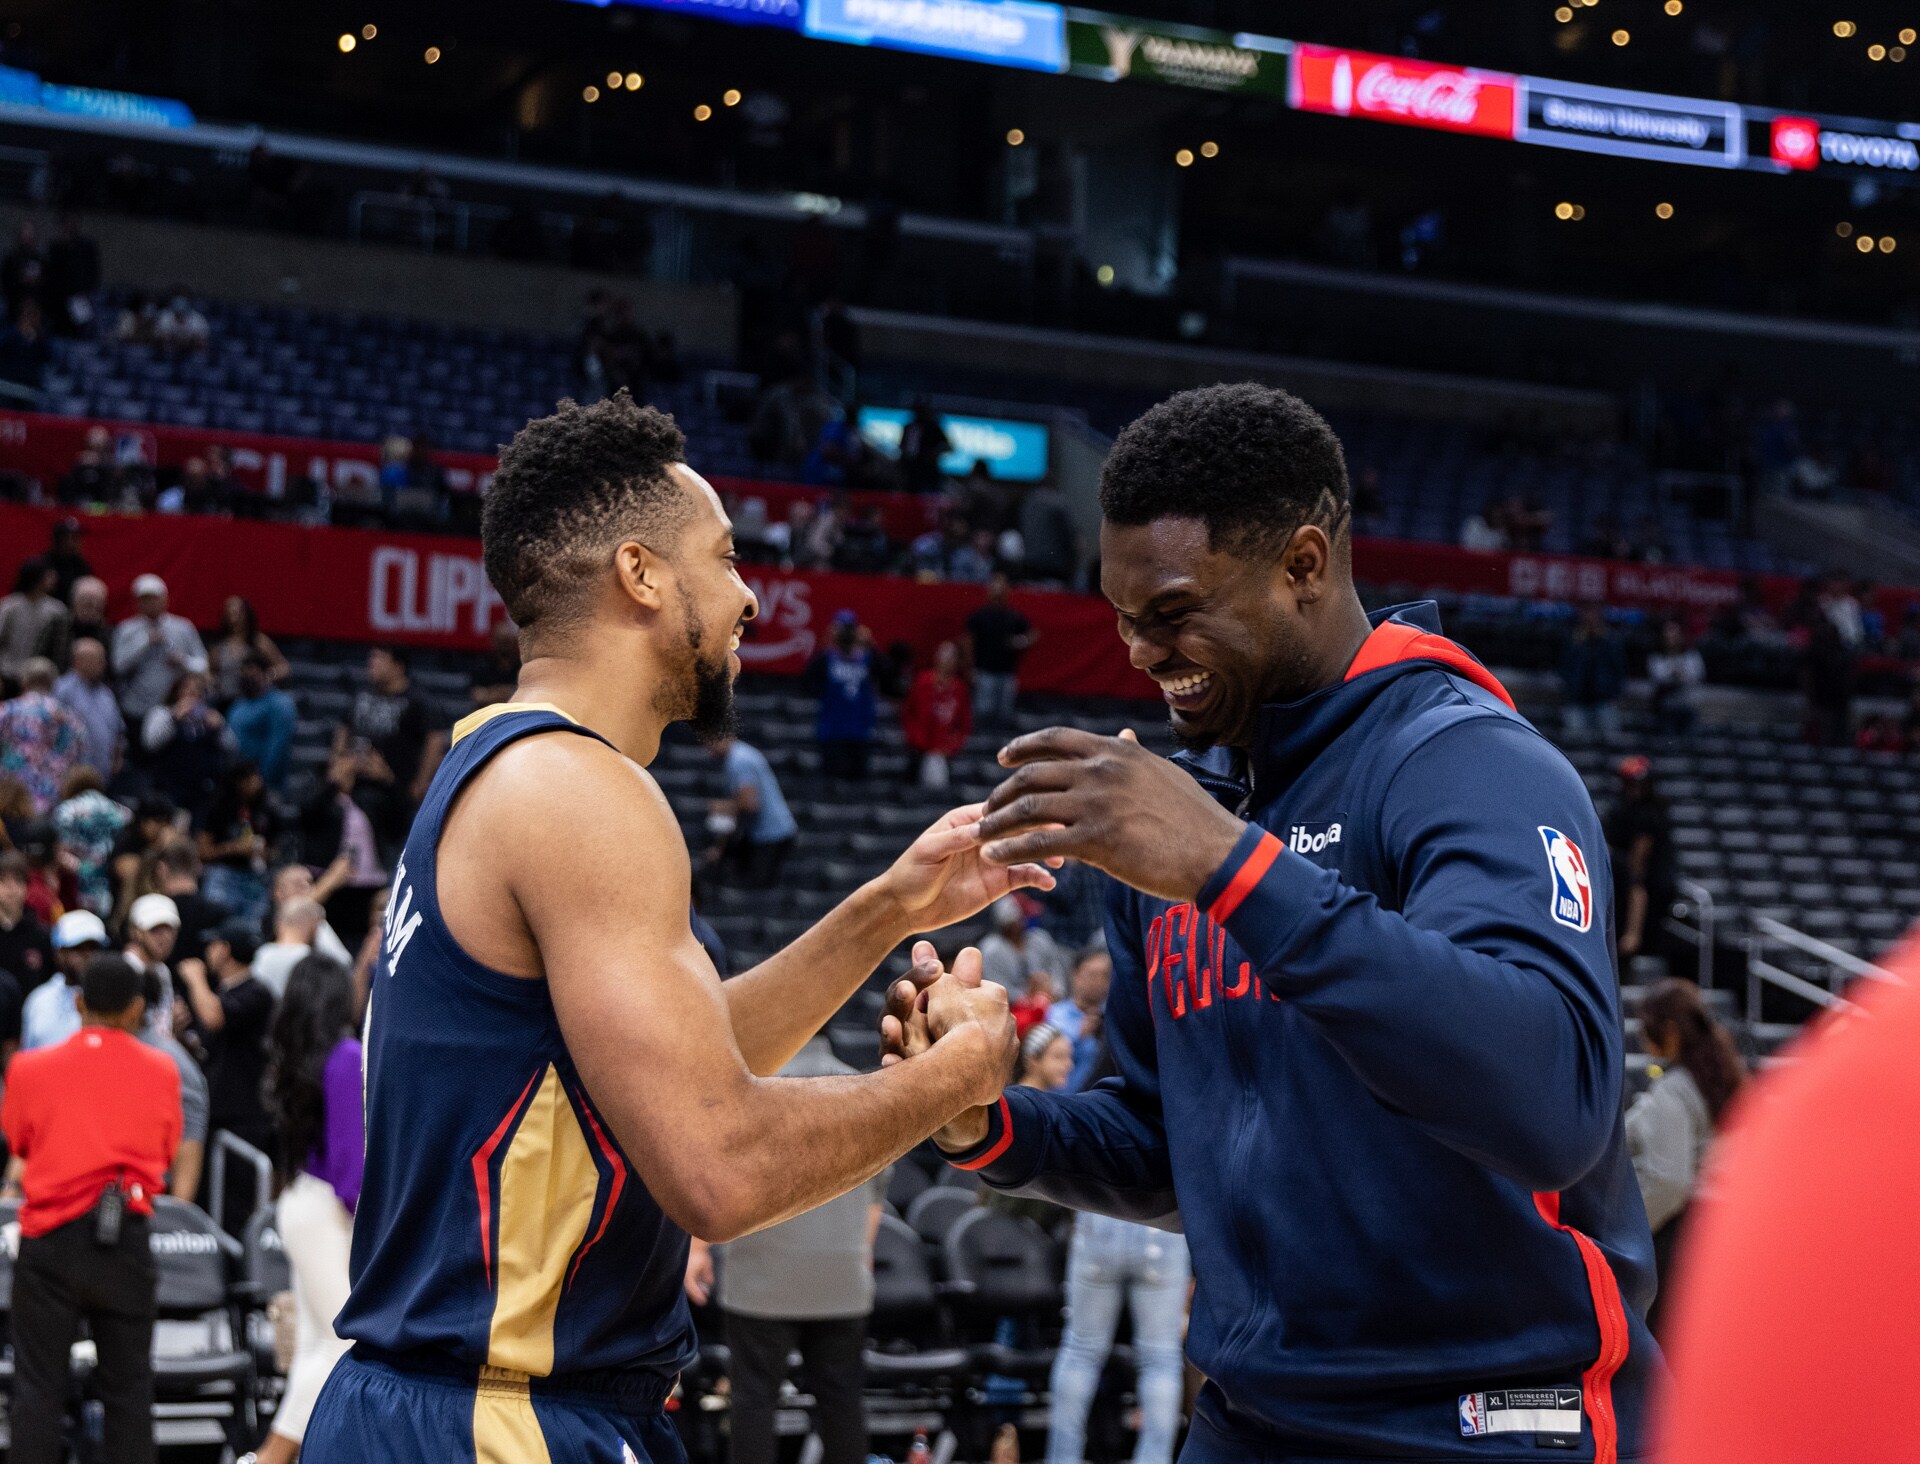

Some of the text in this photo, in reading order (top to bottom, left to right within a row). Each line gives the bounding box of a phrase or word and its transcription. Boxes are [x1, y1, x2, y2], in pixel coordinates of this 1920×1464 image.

[371, 547, 505, 634] CLIPP
[1559, 895, 1579, 920] NBA
[1490, 1396, 1503, 1405] XL
